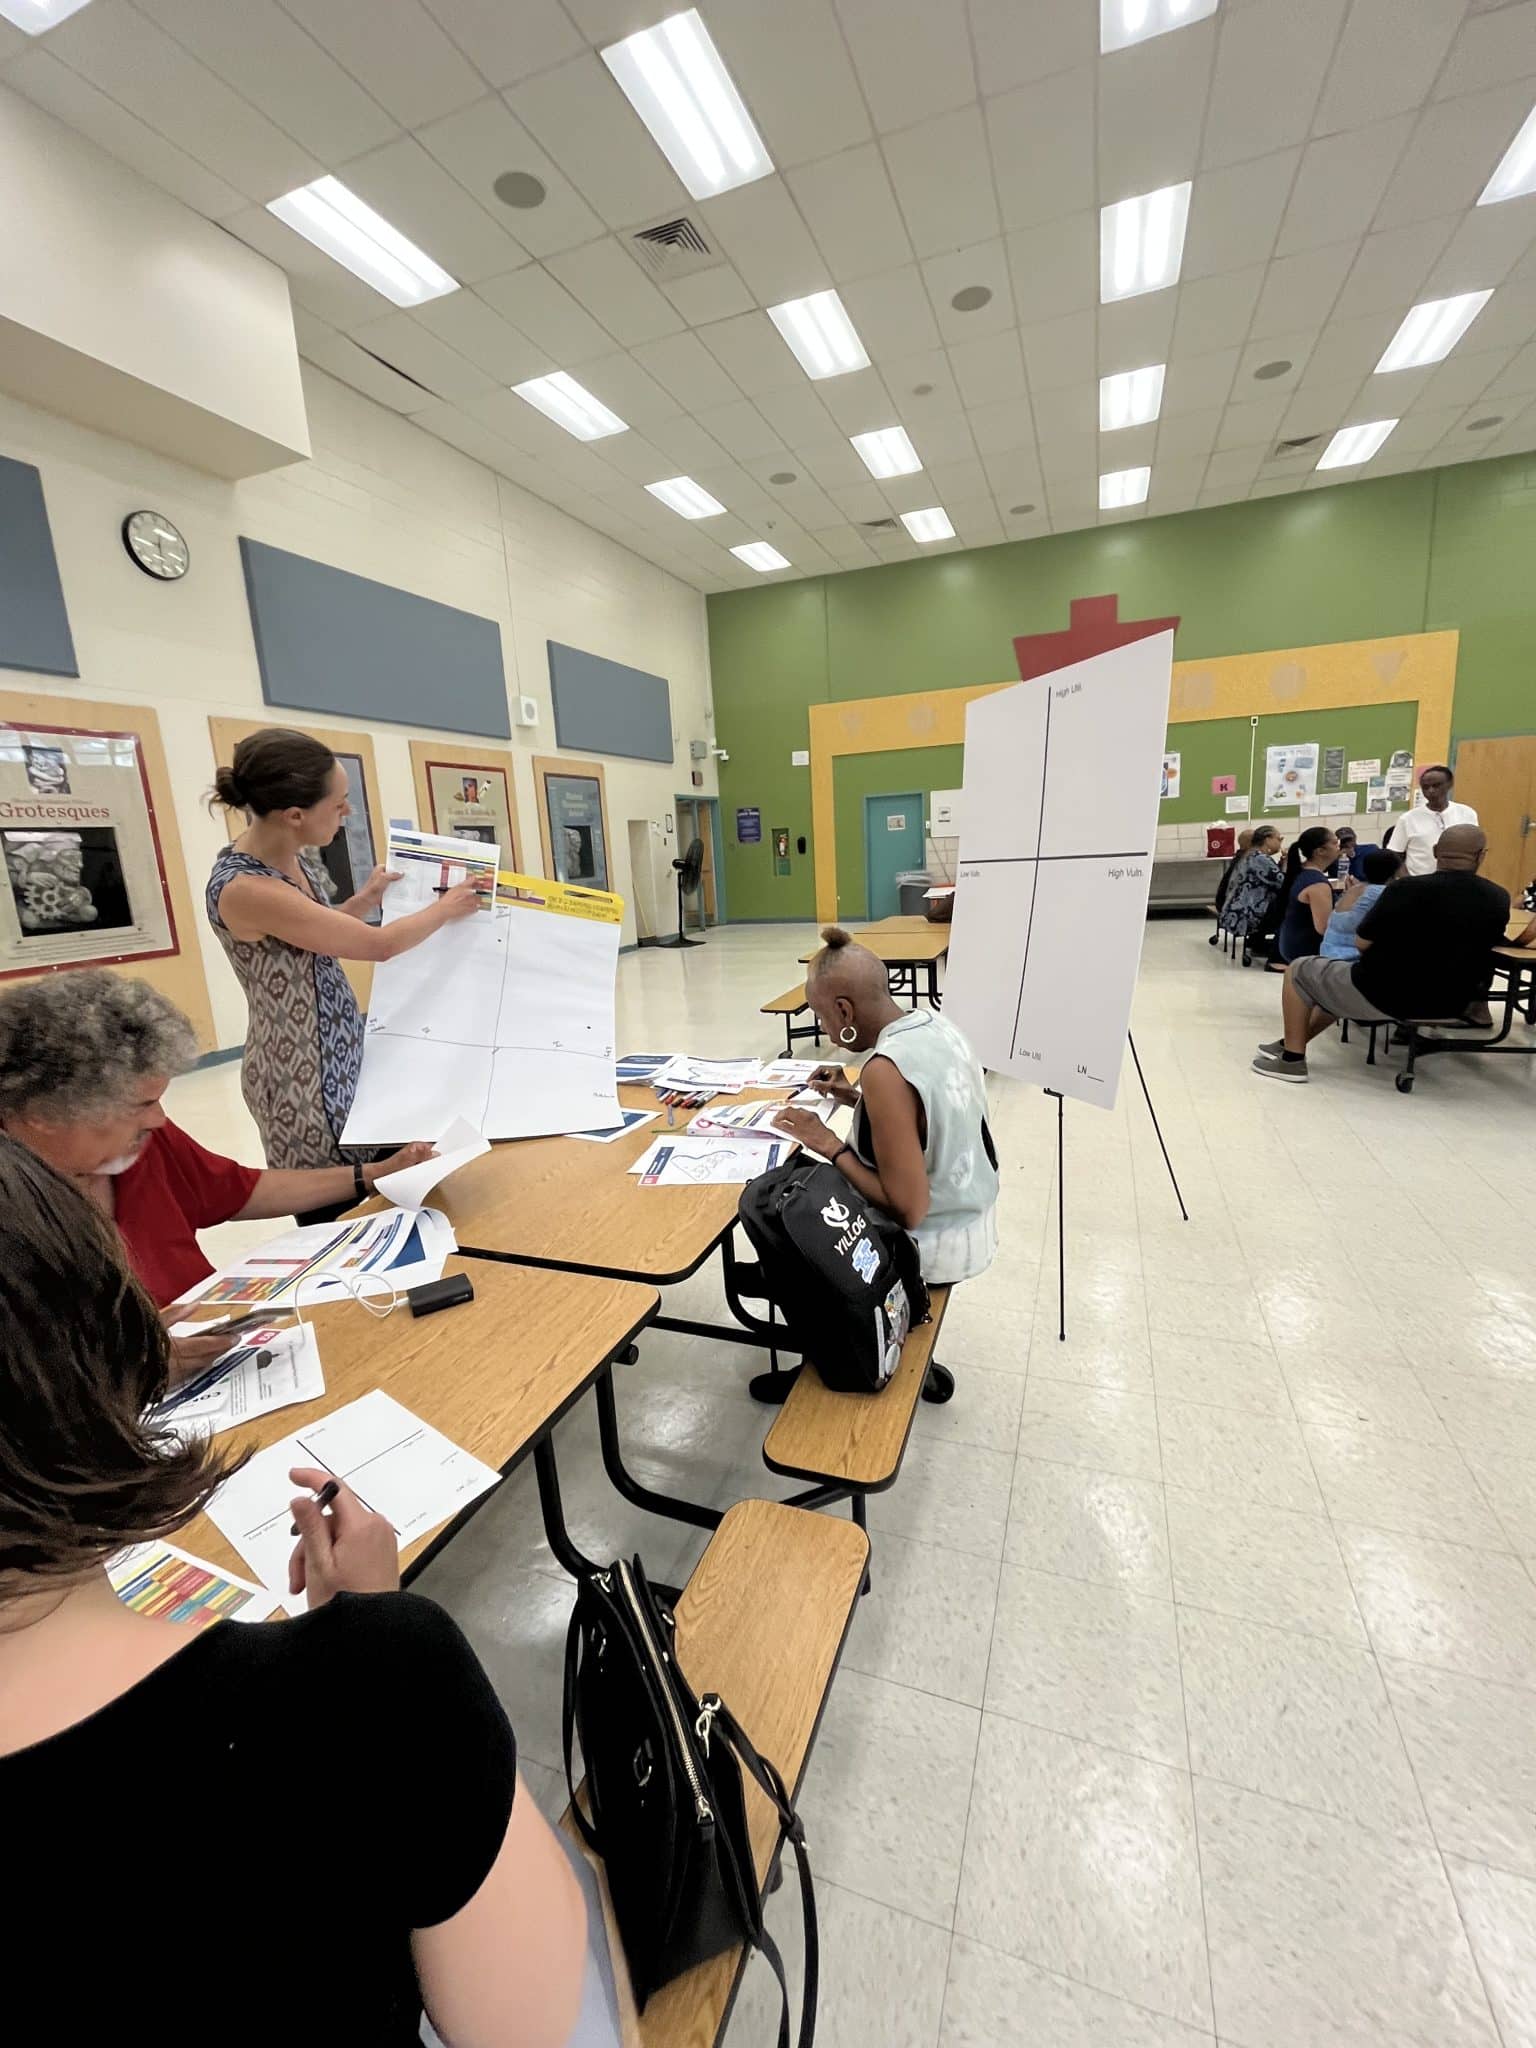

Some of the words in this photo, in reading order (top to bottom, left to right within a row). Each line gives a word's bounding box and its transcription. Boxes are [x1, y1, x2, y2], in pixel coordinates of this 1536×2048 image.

[1220, 783, 1228, 792] K
[0, 802, 110, 821] Grotesques
[833, 1213, 867, 1256] YILLOG
